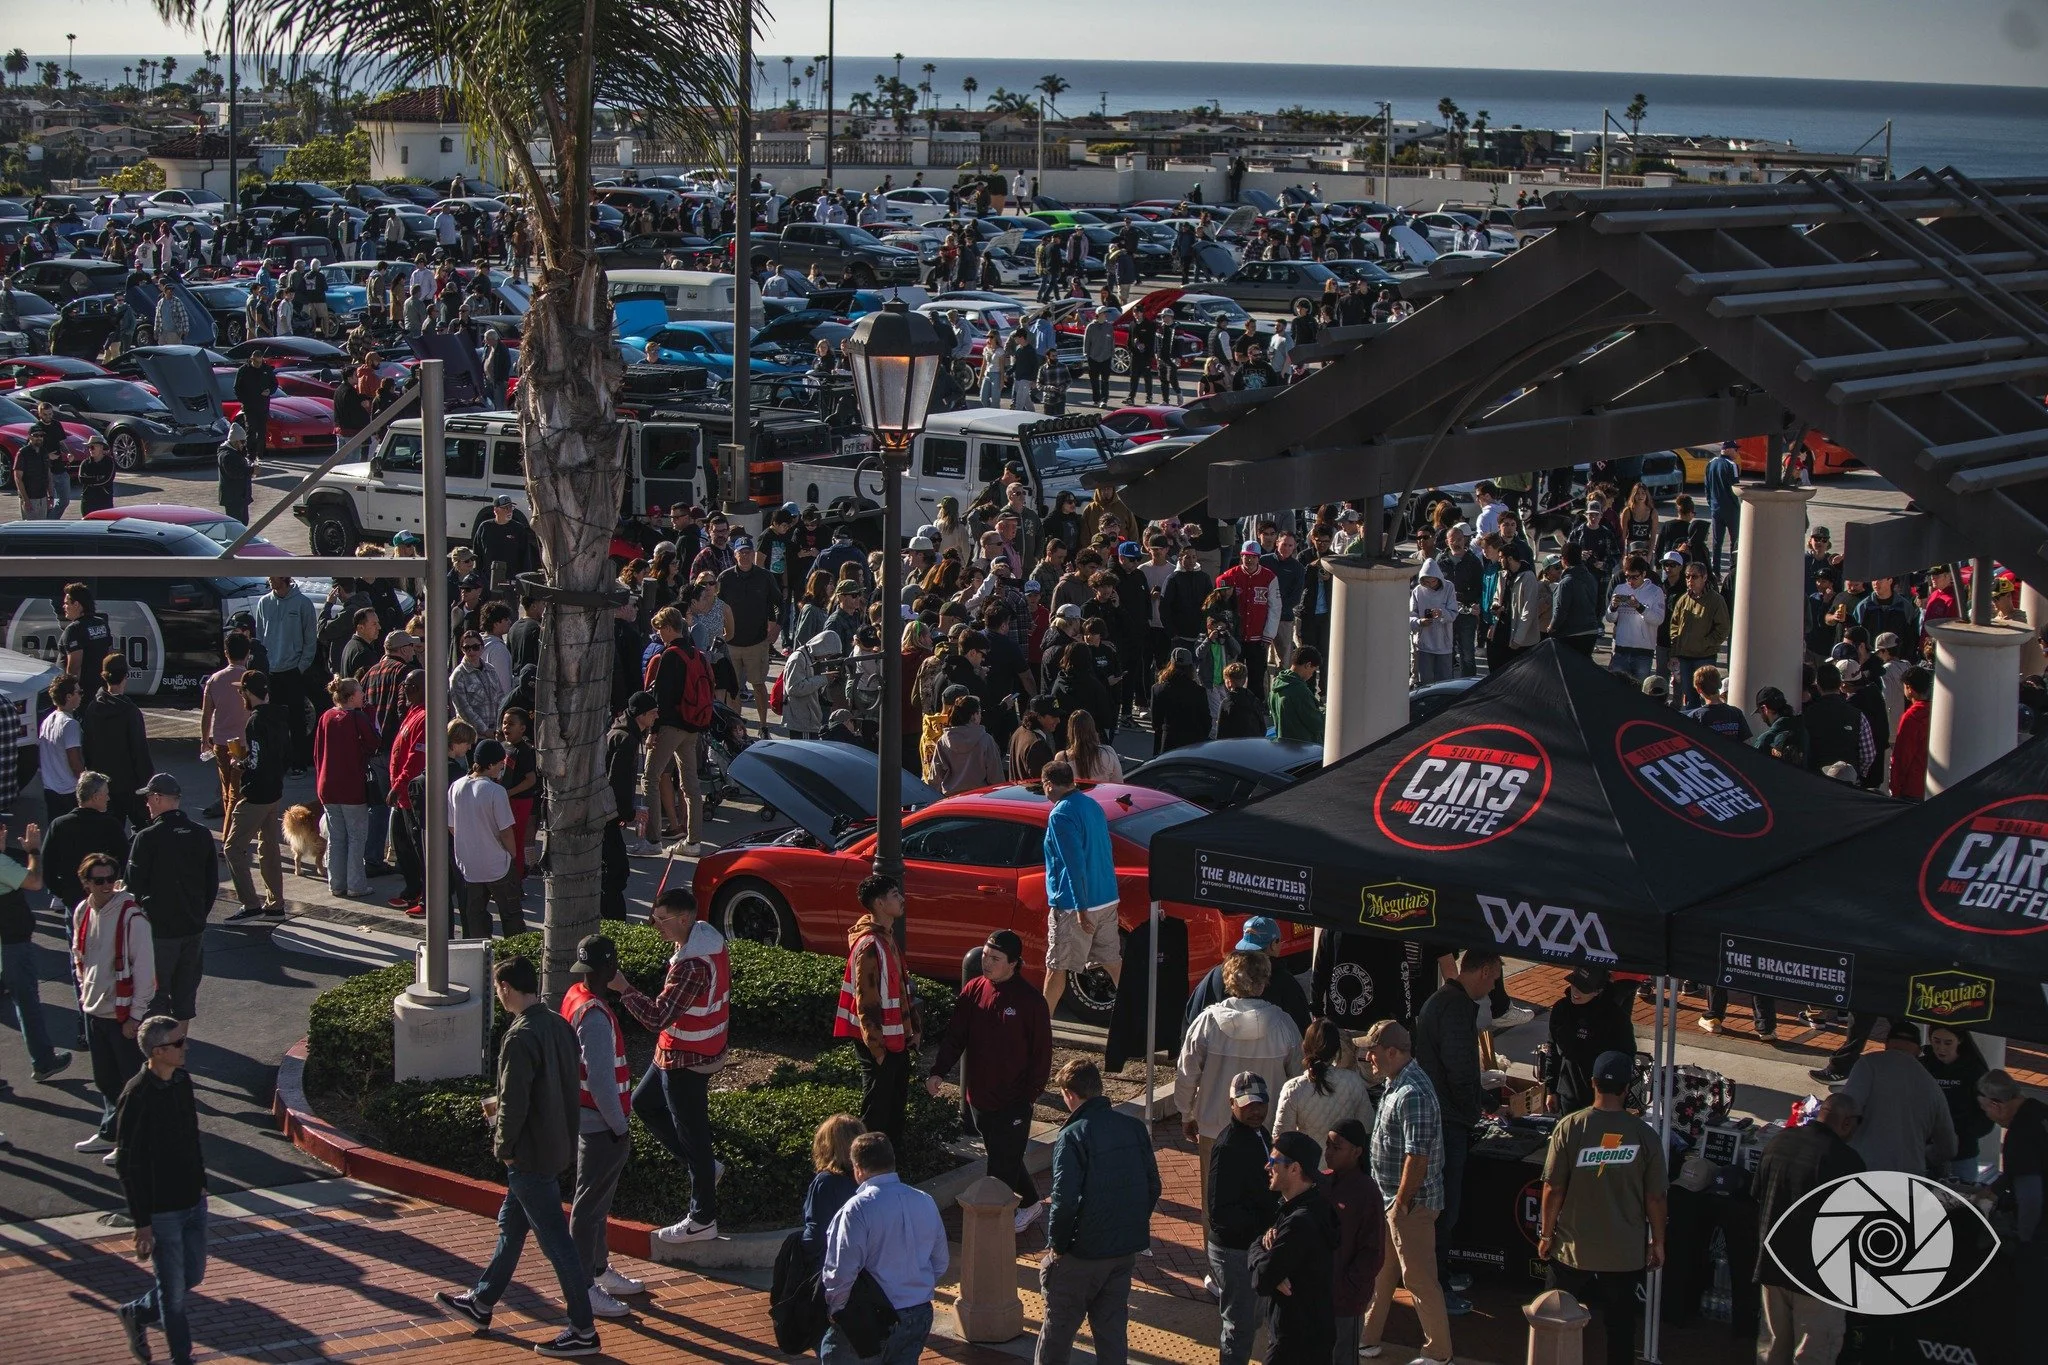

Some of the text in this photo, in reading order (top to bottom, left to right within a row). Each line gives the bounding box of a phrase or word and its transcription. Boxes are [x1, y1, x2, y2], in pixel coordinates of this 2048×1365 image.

[1029, 431, 1096, 446] INTAGE DEFENDERS
[1254, 586, 1268, 604] K
[162, 677, 197, 686] SUNDAYS
[1450, 747, 1494, 761] SOUTH
[1401, 758, 1530, 812] CARS
[1639, 749, 1735, 806] CARS
[1390, 799, 1421, 814] AND
[1697, 786, 1763, 822] COFFEE
[1408, 802, 1505, 836] COFFEE
[1947, 832, 2048, 893] CAR
[1200, 866, 1306, 895] THE BRACKETEER
[1937, 880, 1969, 894] AND
[1366, 891, 1430, 919] Meguiar's
[1542, 948, 1617, 965] WEHR MEDIA
[1726, 951, 1846, 984] THE BRACKETEER
[1725, 967, 1846, 992] AUTOMOTIVE FIRE EXTINGUISHER BRACKETS
[1916, 981, 1988, 1012] Meguiar's
[1582, 1147, 1634, 1163] Legends
[1462, 1250, 1504, 1262] BRACKETEER
